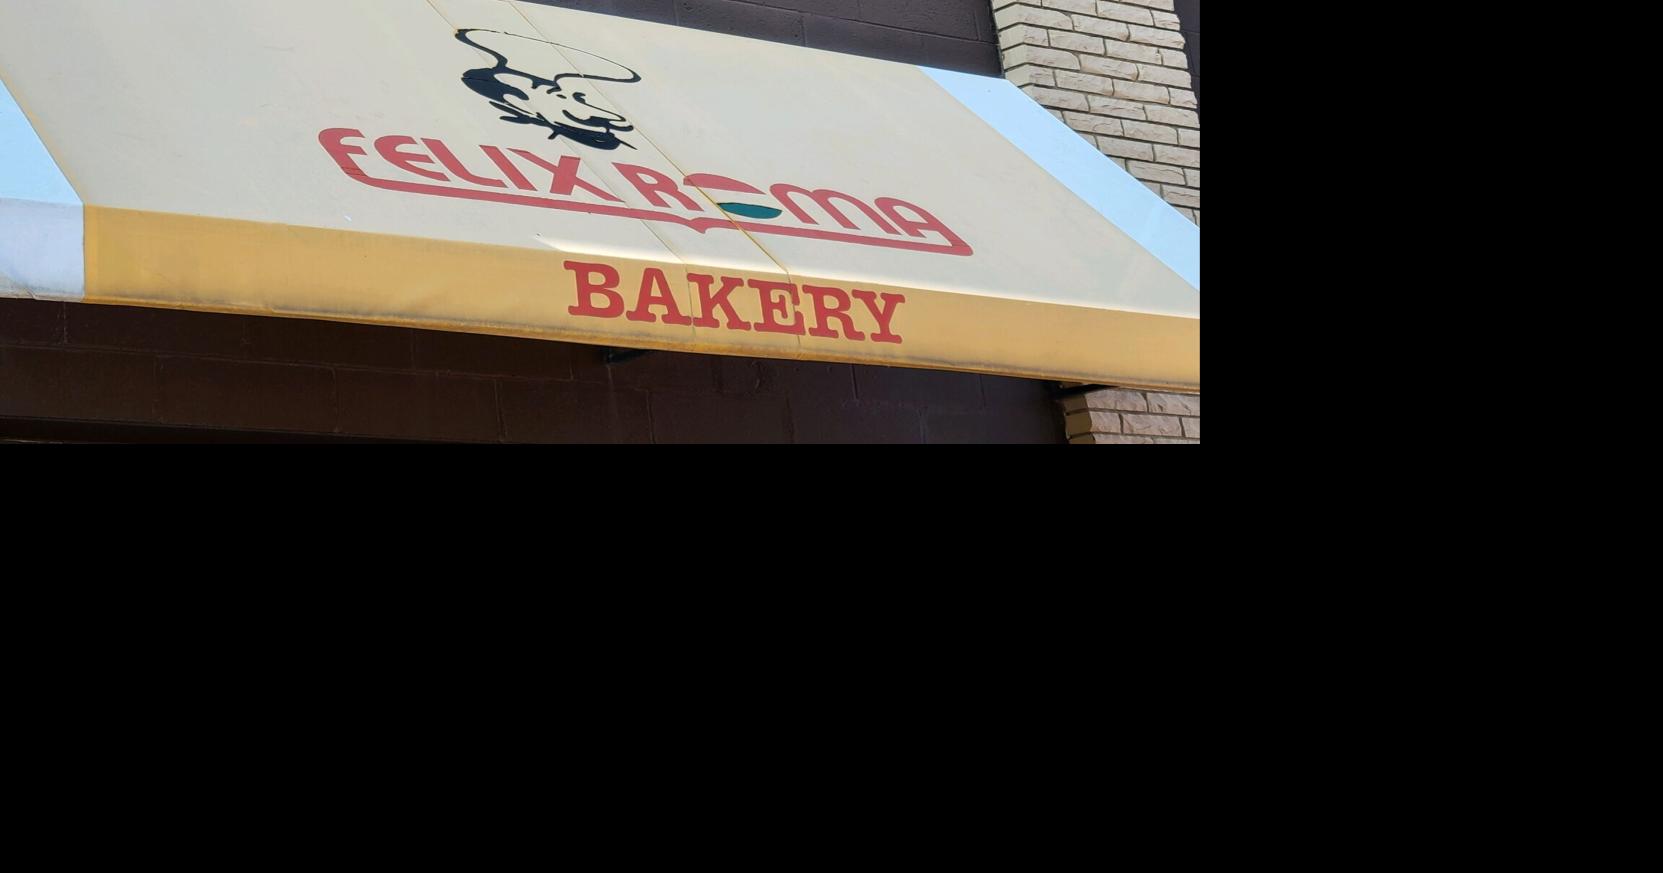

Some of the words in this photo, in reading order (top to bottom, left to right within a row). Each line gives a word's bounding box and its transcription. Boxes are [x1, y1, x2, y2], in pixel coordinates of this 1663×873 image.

[319, 128, 624, 203] FELIX
[612, 163, 972, 256] ROMA
[563, 260, 906, 346] BAKERY
